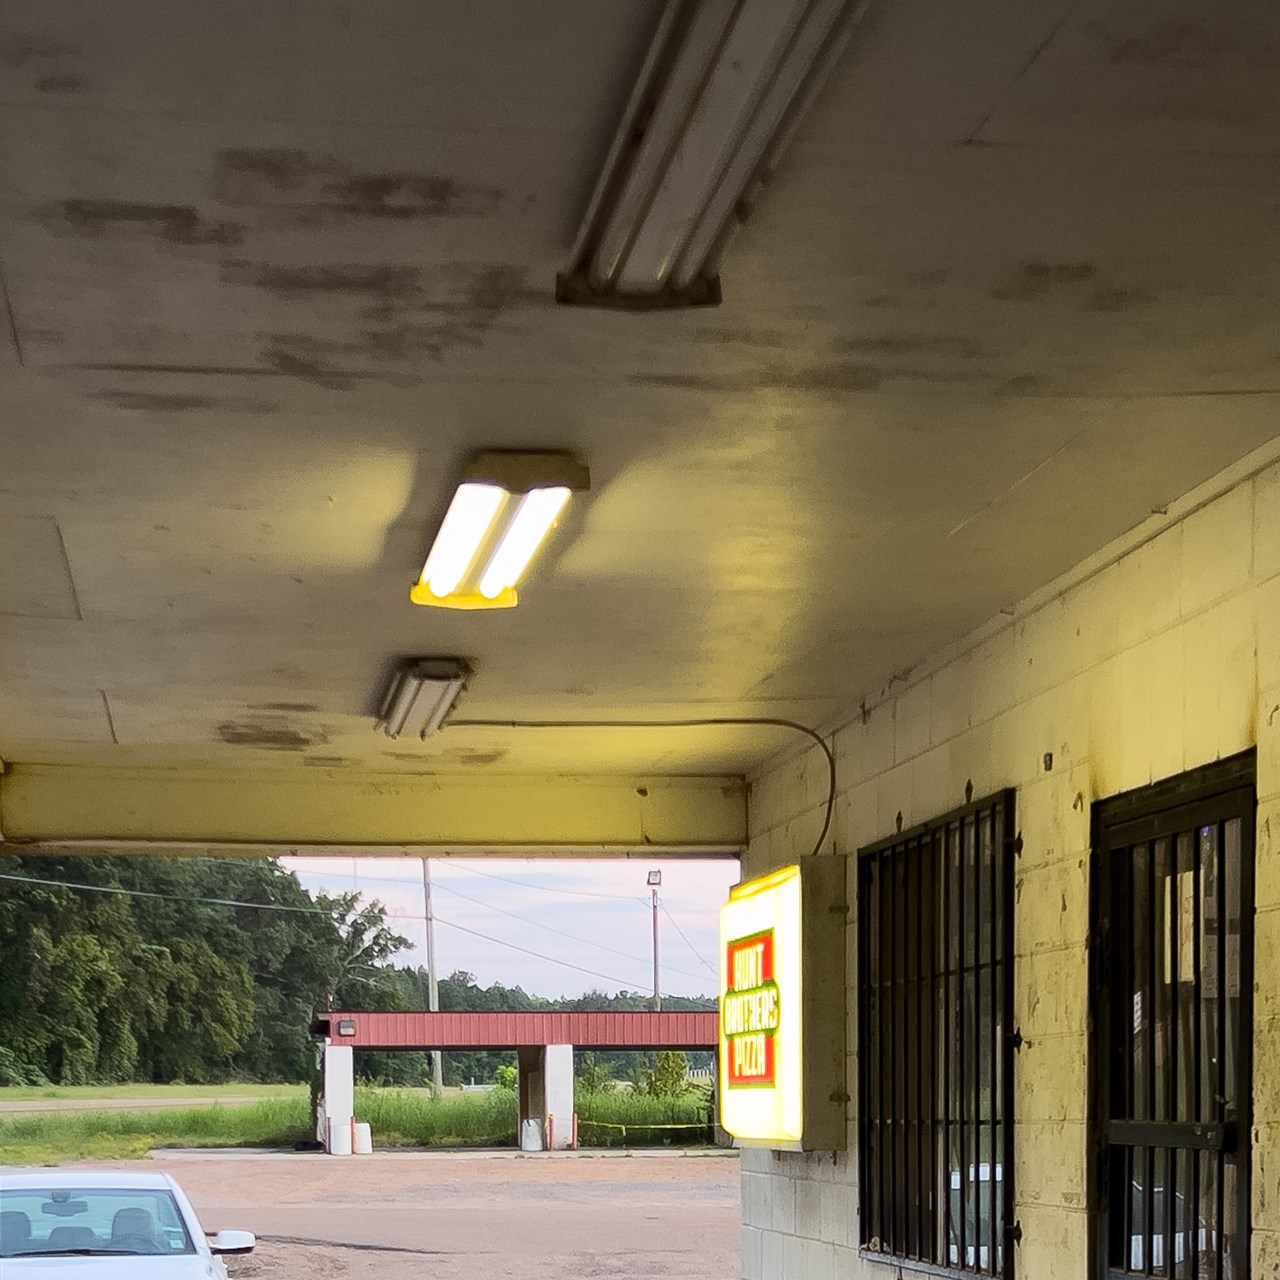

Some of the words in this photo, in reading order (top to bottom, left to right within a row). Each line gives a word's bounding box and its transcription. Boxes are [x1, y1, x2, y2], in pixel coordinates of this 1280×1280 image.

[734, 943, 764, 992] HUNT
[725, 988, 778, 1035] BROTHERS
[734, 1034, 766, 1077] PIZZA
